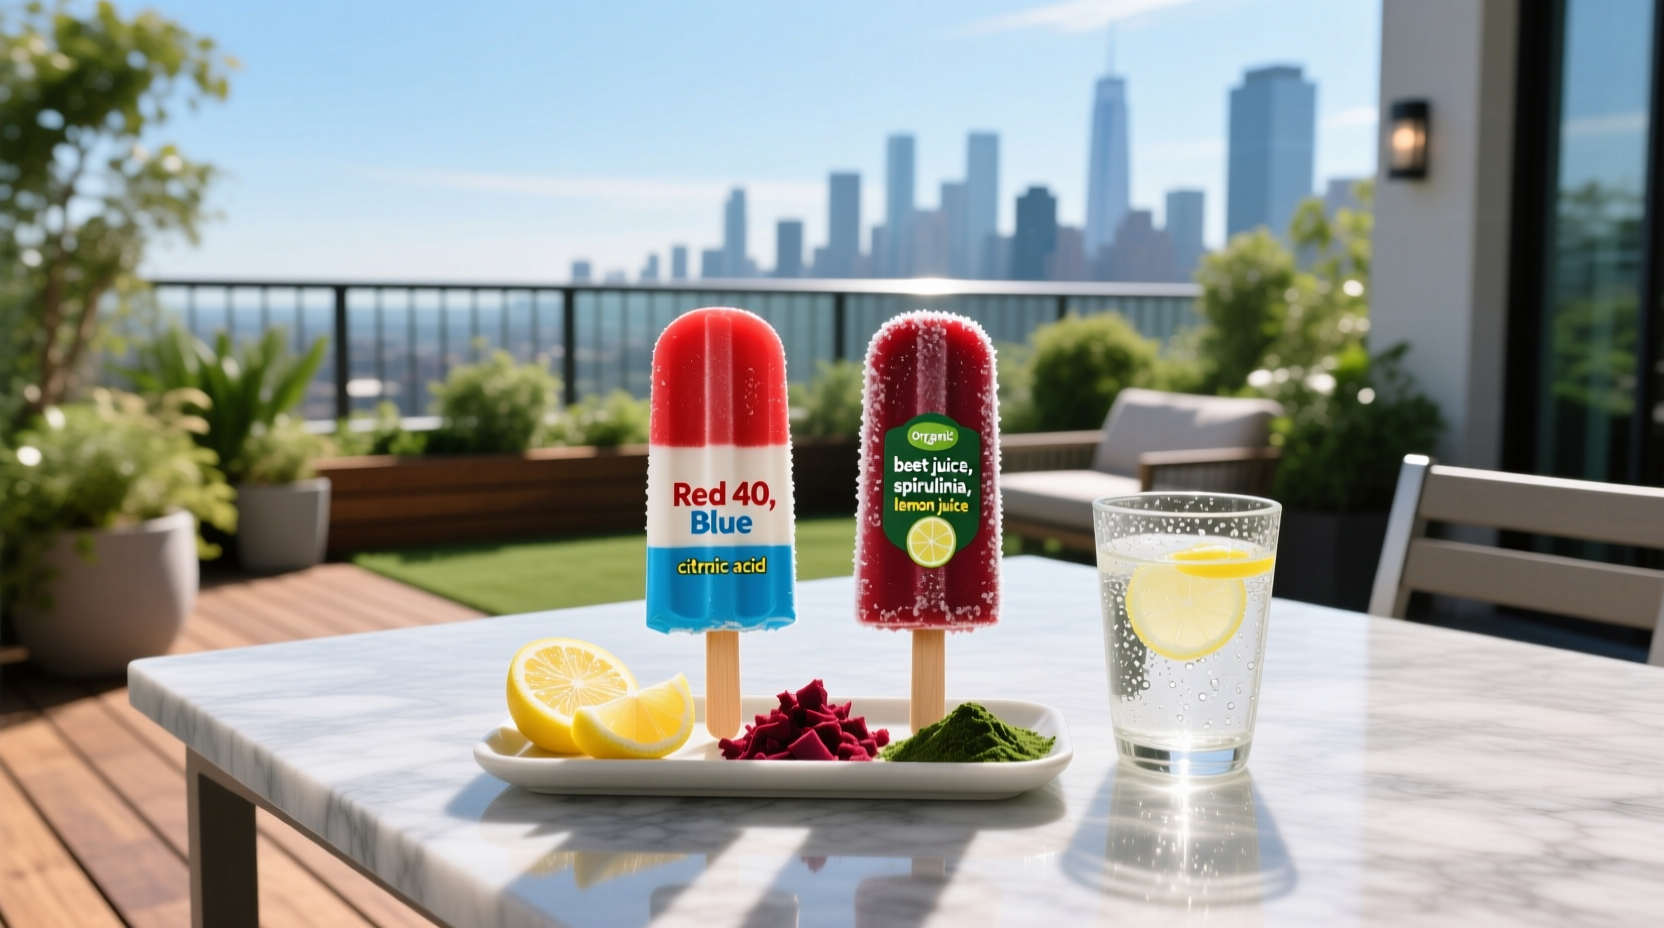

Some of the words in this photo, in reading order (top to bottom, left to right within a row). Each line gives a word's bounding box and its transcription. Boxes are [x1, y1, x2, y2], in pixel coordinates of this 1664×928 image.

[894, 455, 929, 472] beet
[931, 457, 973, 477] juice,
[673, 481, 726, 507] Red
[732, 481, 776, 511] 40,
[894, 477, 971, 497] spirulinia,
[894, 497, 935, 512] lemon
[937, 497, 969, 516] juice
[691, 509, 753, 535] Blue
[732, 556, 766, 574] acid
